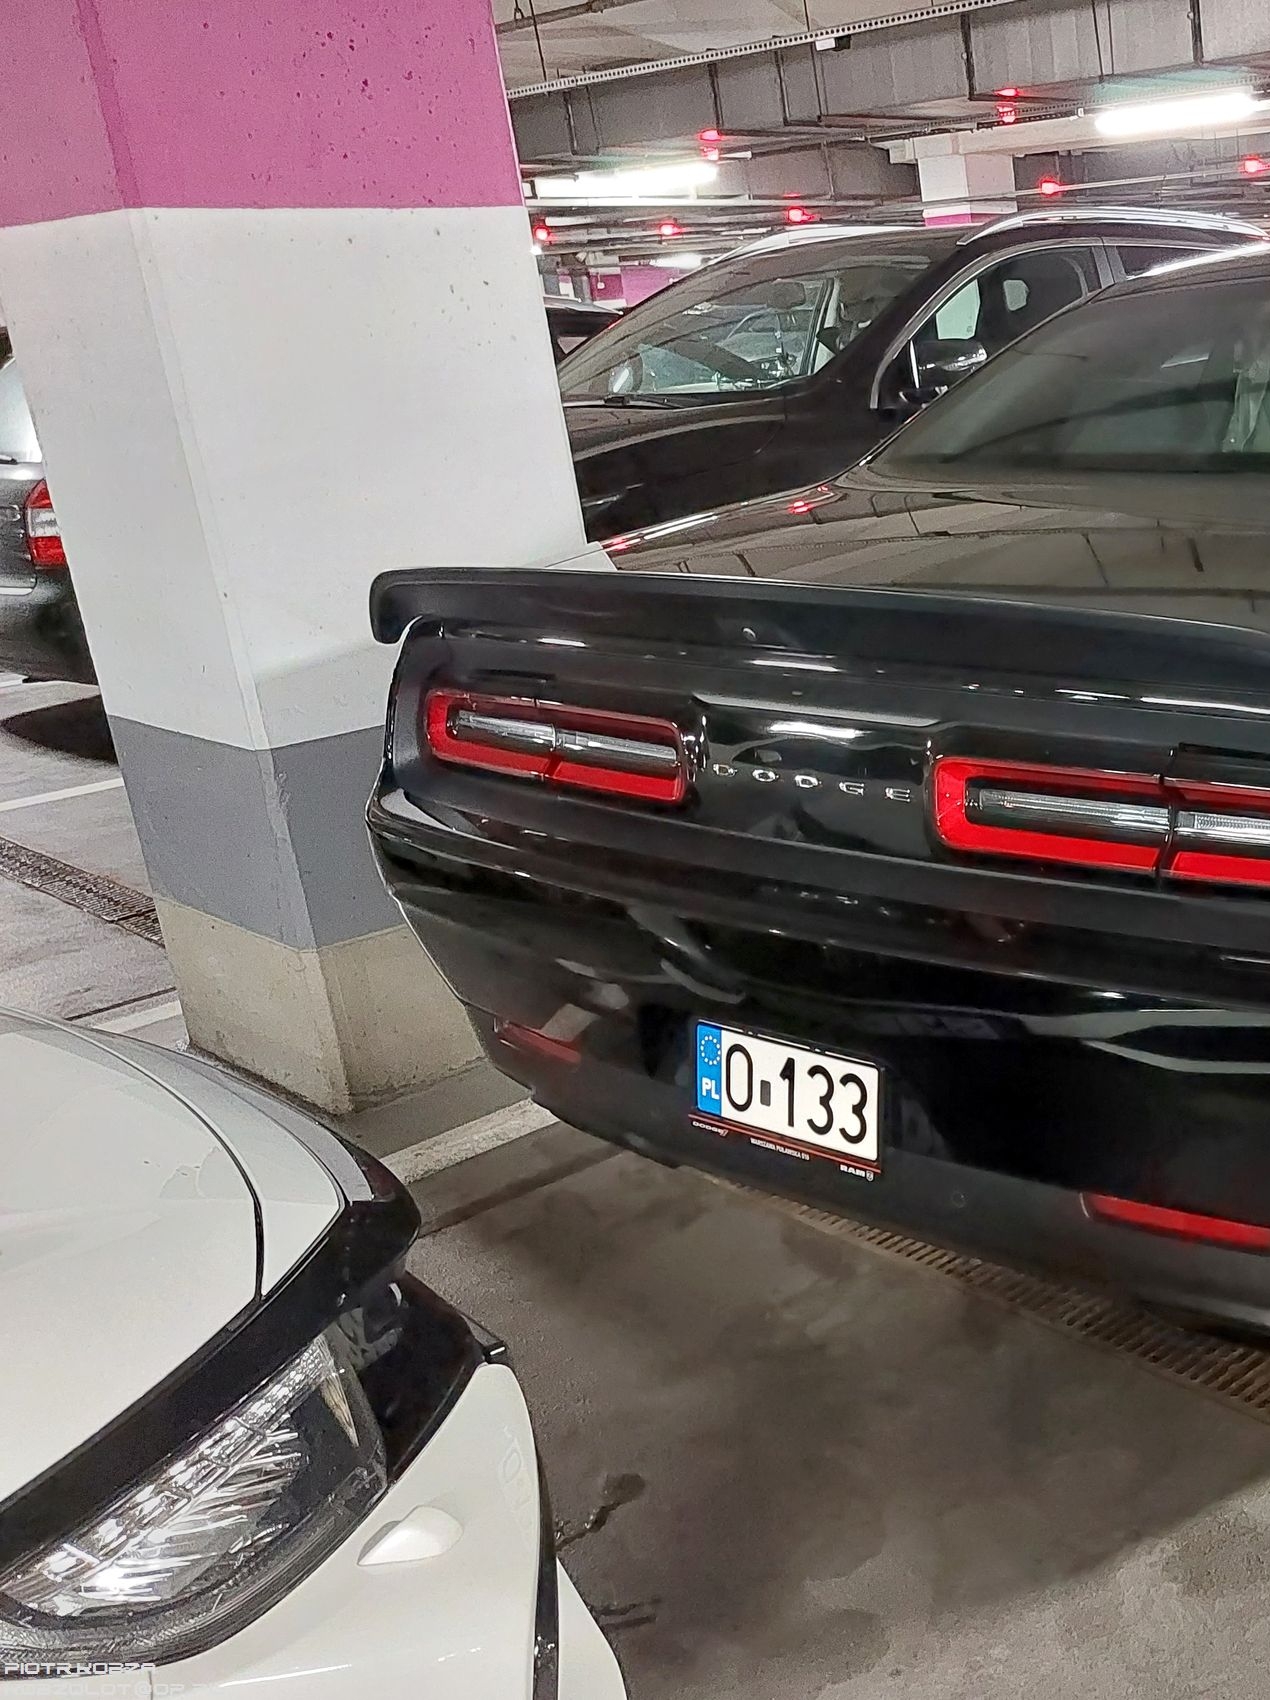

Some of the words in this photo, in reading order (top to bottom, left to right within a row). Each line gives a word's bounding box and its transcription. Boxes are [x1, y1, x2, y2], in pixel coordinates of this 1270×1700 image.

[712, 762, 912, 803] DODGE
[701, 1077, 720, 1100] PL
[779, 1057, 868, 1144] 133
[692, 1120, 724, 1135] DODGE
[839, 1164, 867, 1178] RAM
